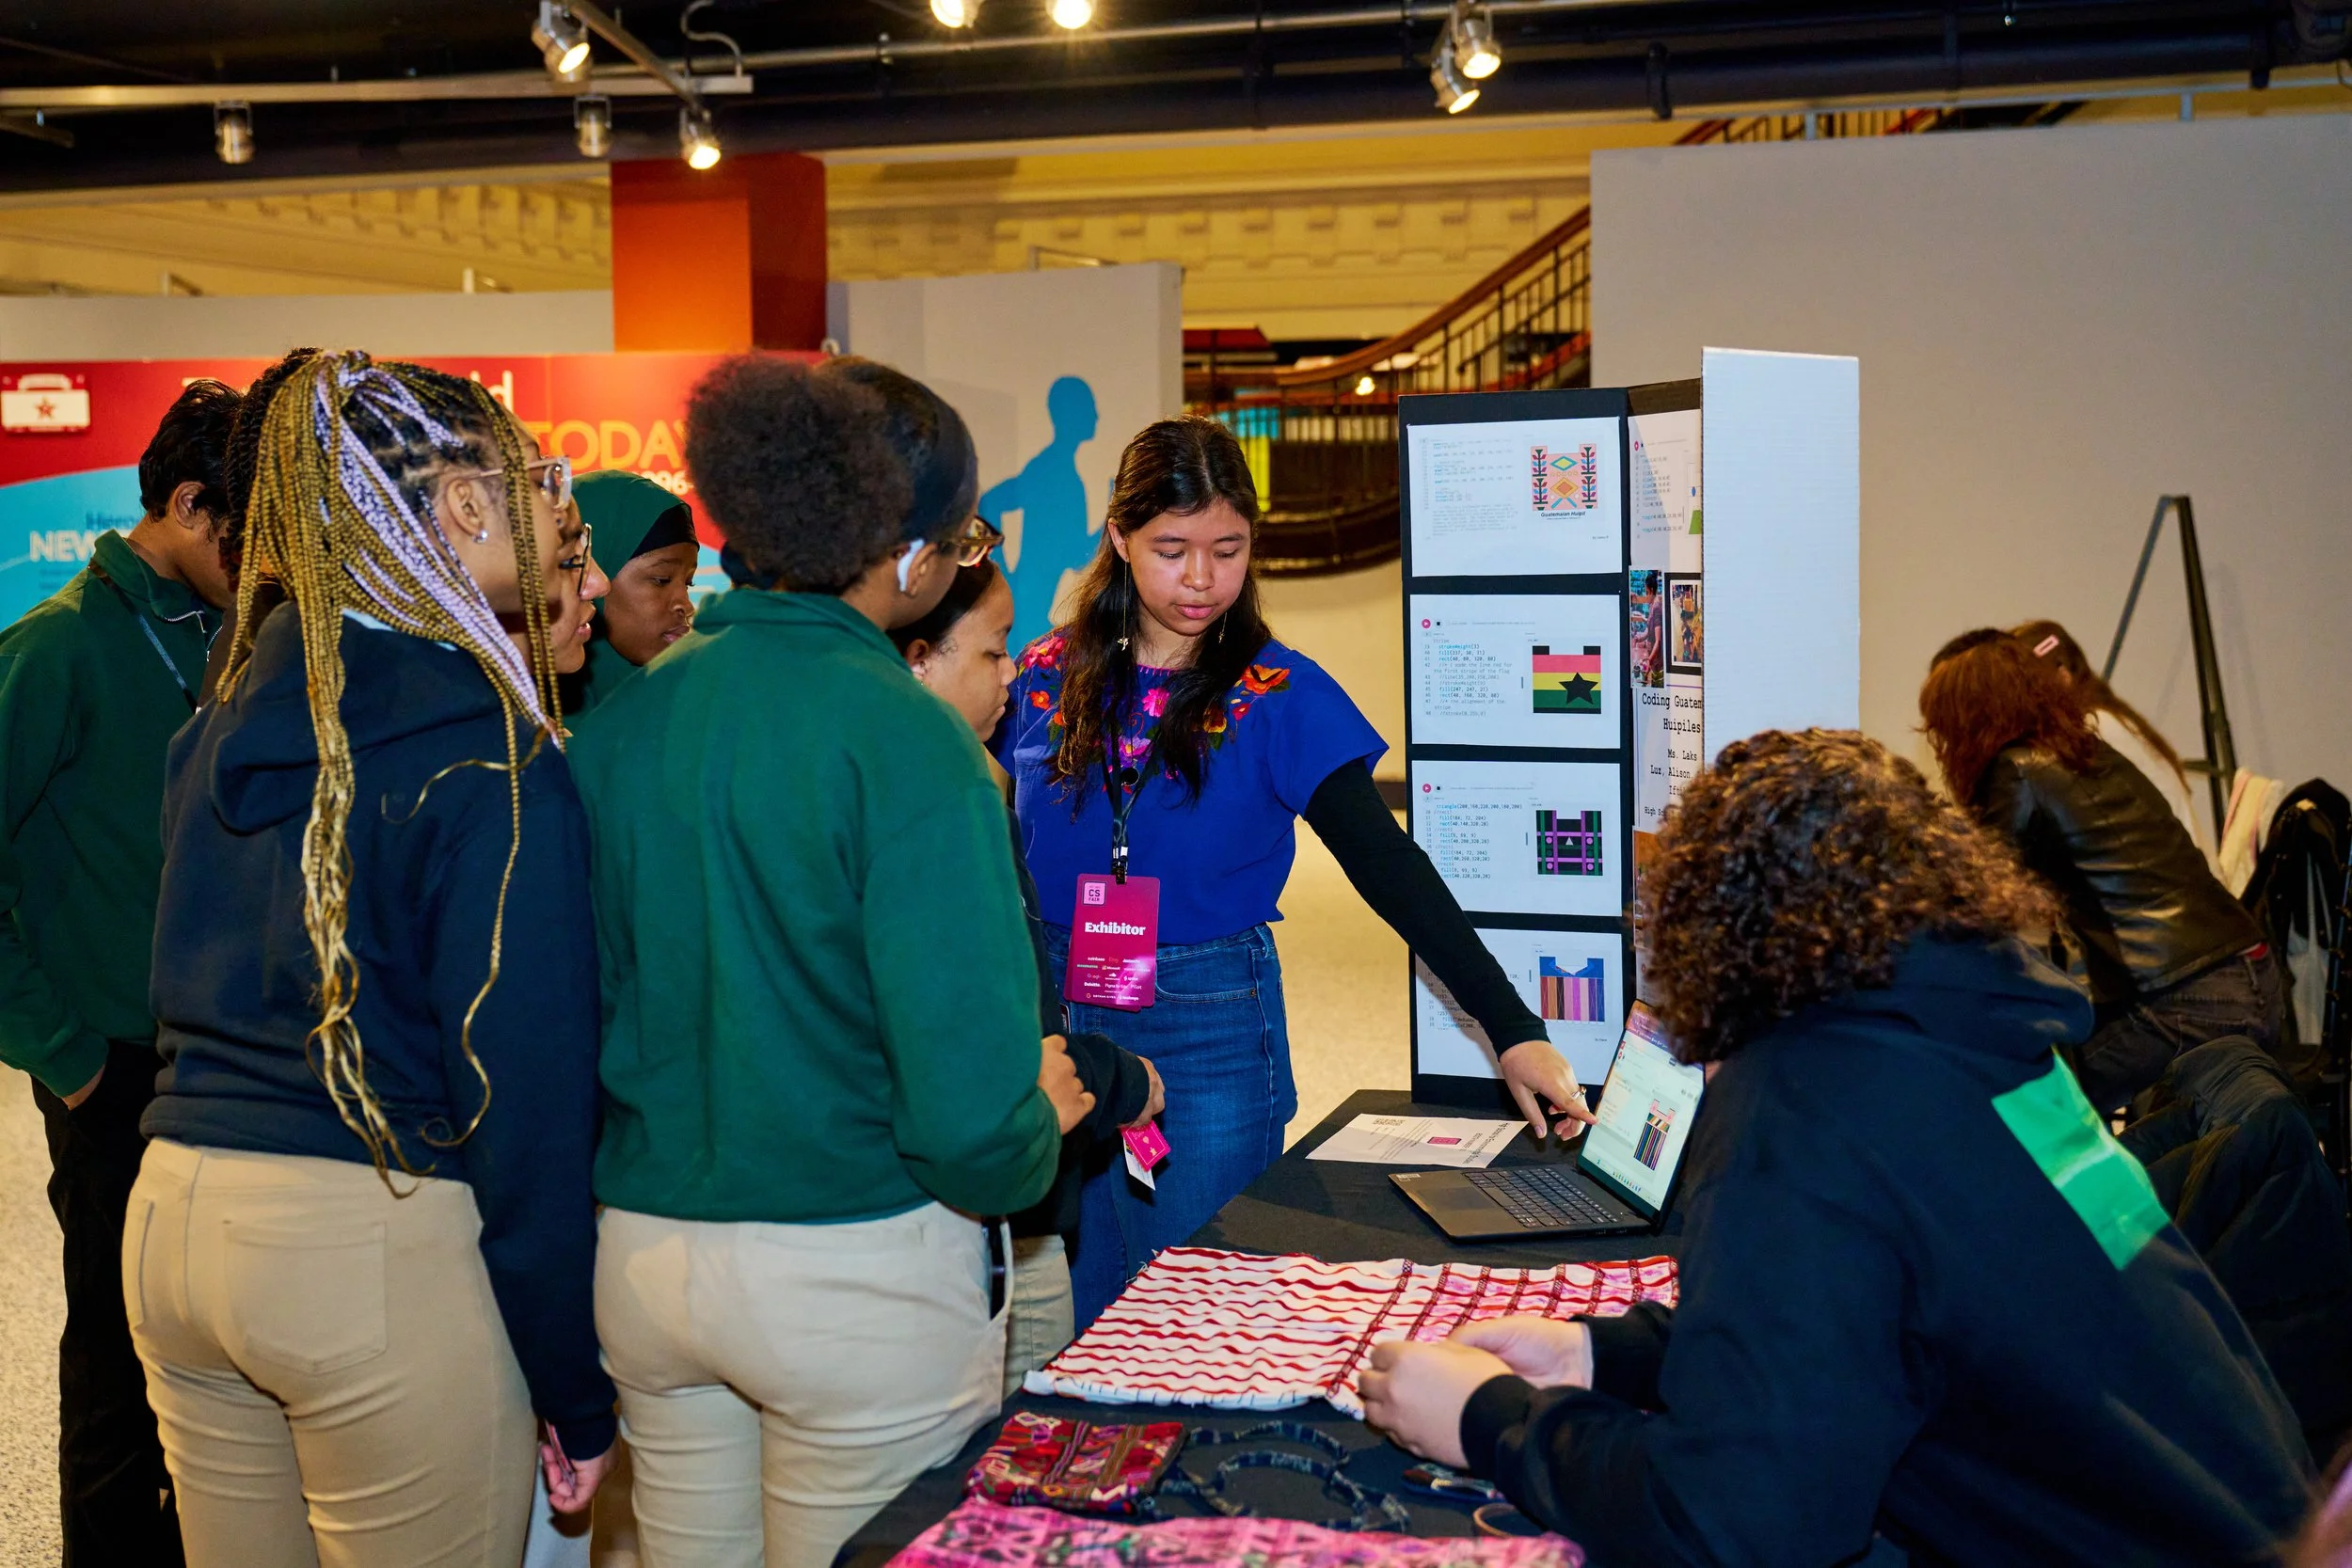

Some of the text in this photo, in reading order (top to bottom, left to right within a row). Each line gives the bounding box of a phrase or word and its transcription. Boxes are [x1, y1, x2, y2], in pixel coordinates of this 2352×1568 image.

[521, 420, 691, 470] TODA
[1642, 693, 1702, 710] Coding Guatem
[1663, 718, 1700, 735] Huipiles
[1668, 749, 1697, 761] Ms. Laks
[1650, 765, 1665, 777] Luz,
[1089, 889, 1100, 897] CS
[1085, 922, 1146, 936] Exhibitor
